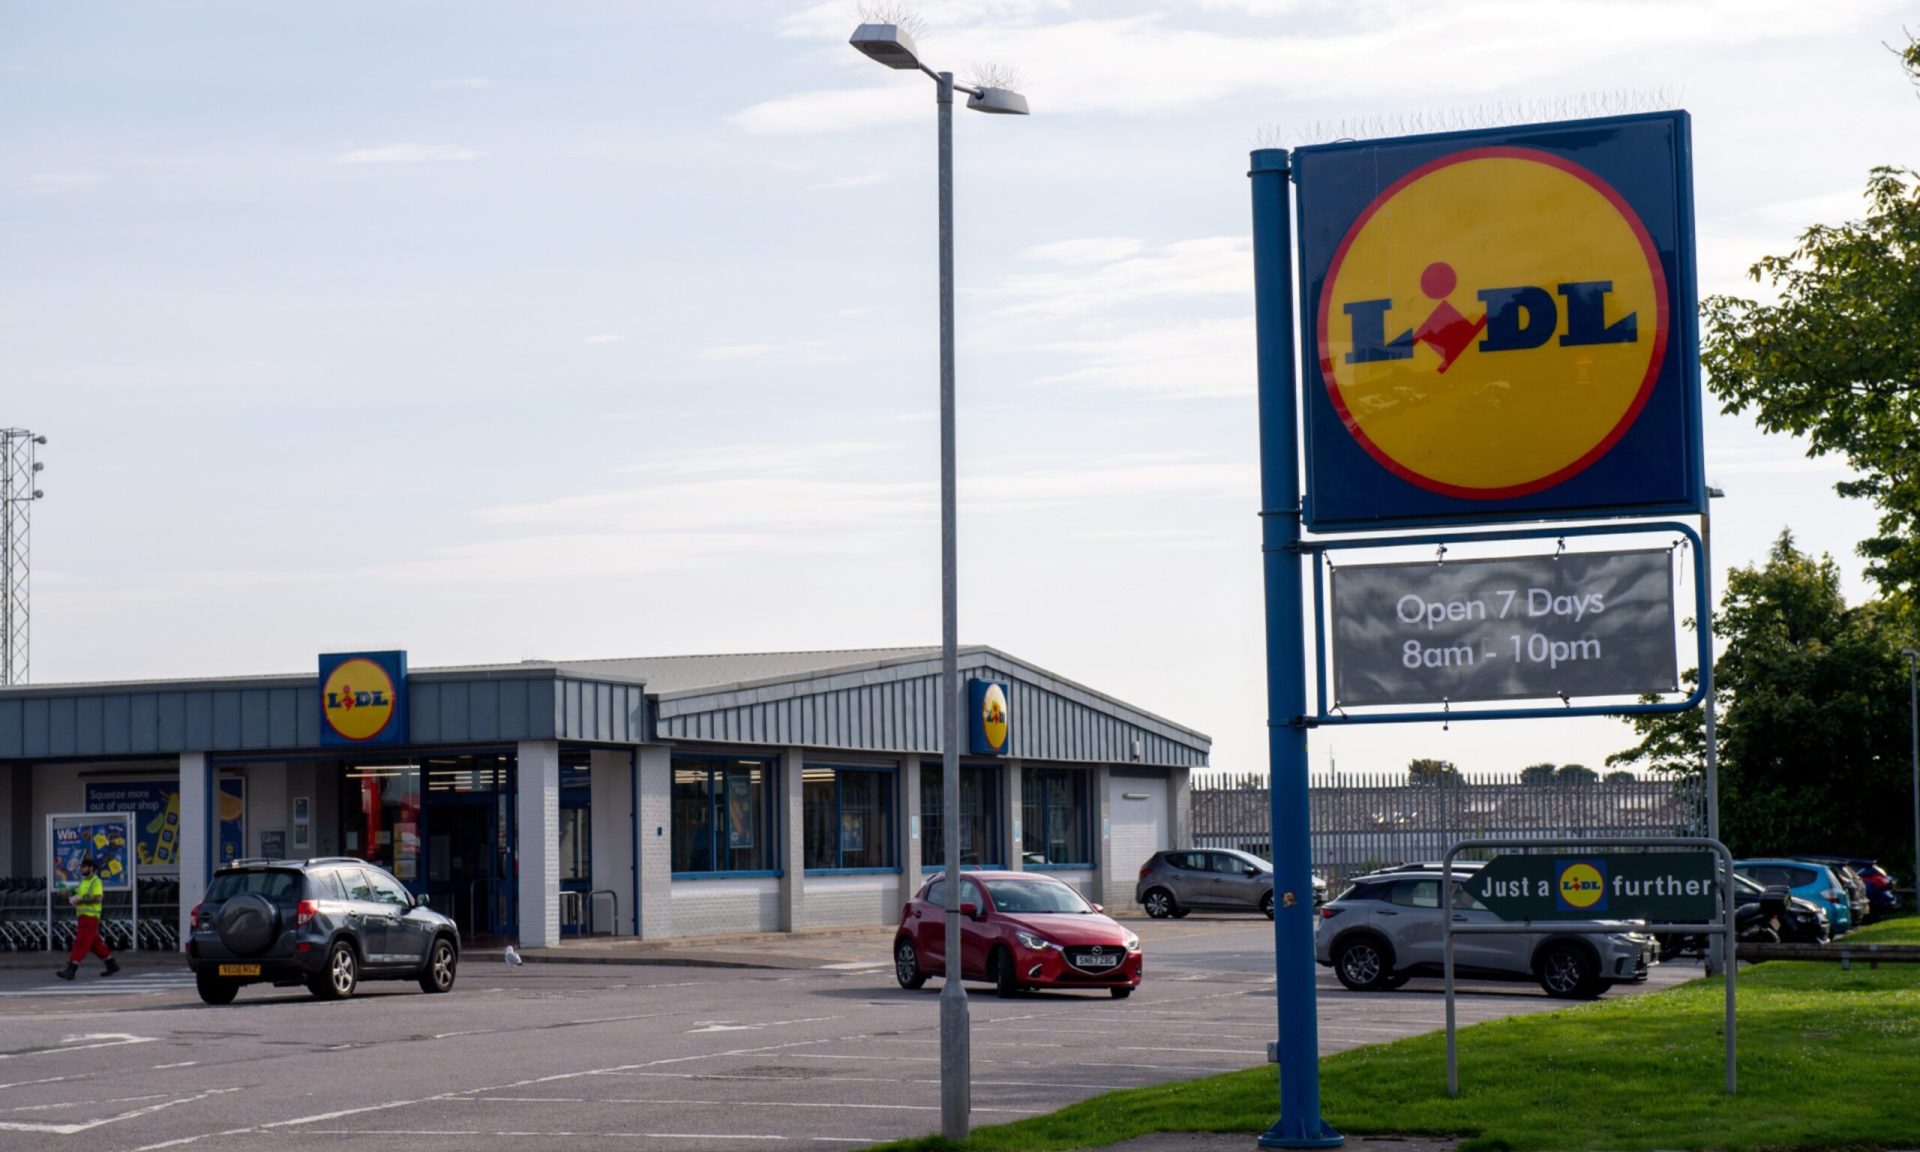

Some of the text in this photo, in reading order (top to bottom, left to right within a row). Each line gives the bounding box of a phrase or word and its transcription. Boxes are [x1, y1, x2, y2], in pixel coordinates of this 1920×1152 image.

[1396, 588, 1605, 630] Open 7 Days
[1402, 639, 1474, 669] 8am
[1510, 632, 1601, 669] 10pm
[90, 790, 150, 801] Squeeze more
[90, 800, 160, 812] out of your shop
[57, 828, 77, 841] Win
[1481, 877, 1530, 898] Just
[1538, 880, 1549, 897] a
[1612, 875, 1712, 896] further
